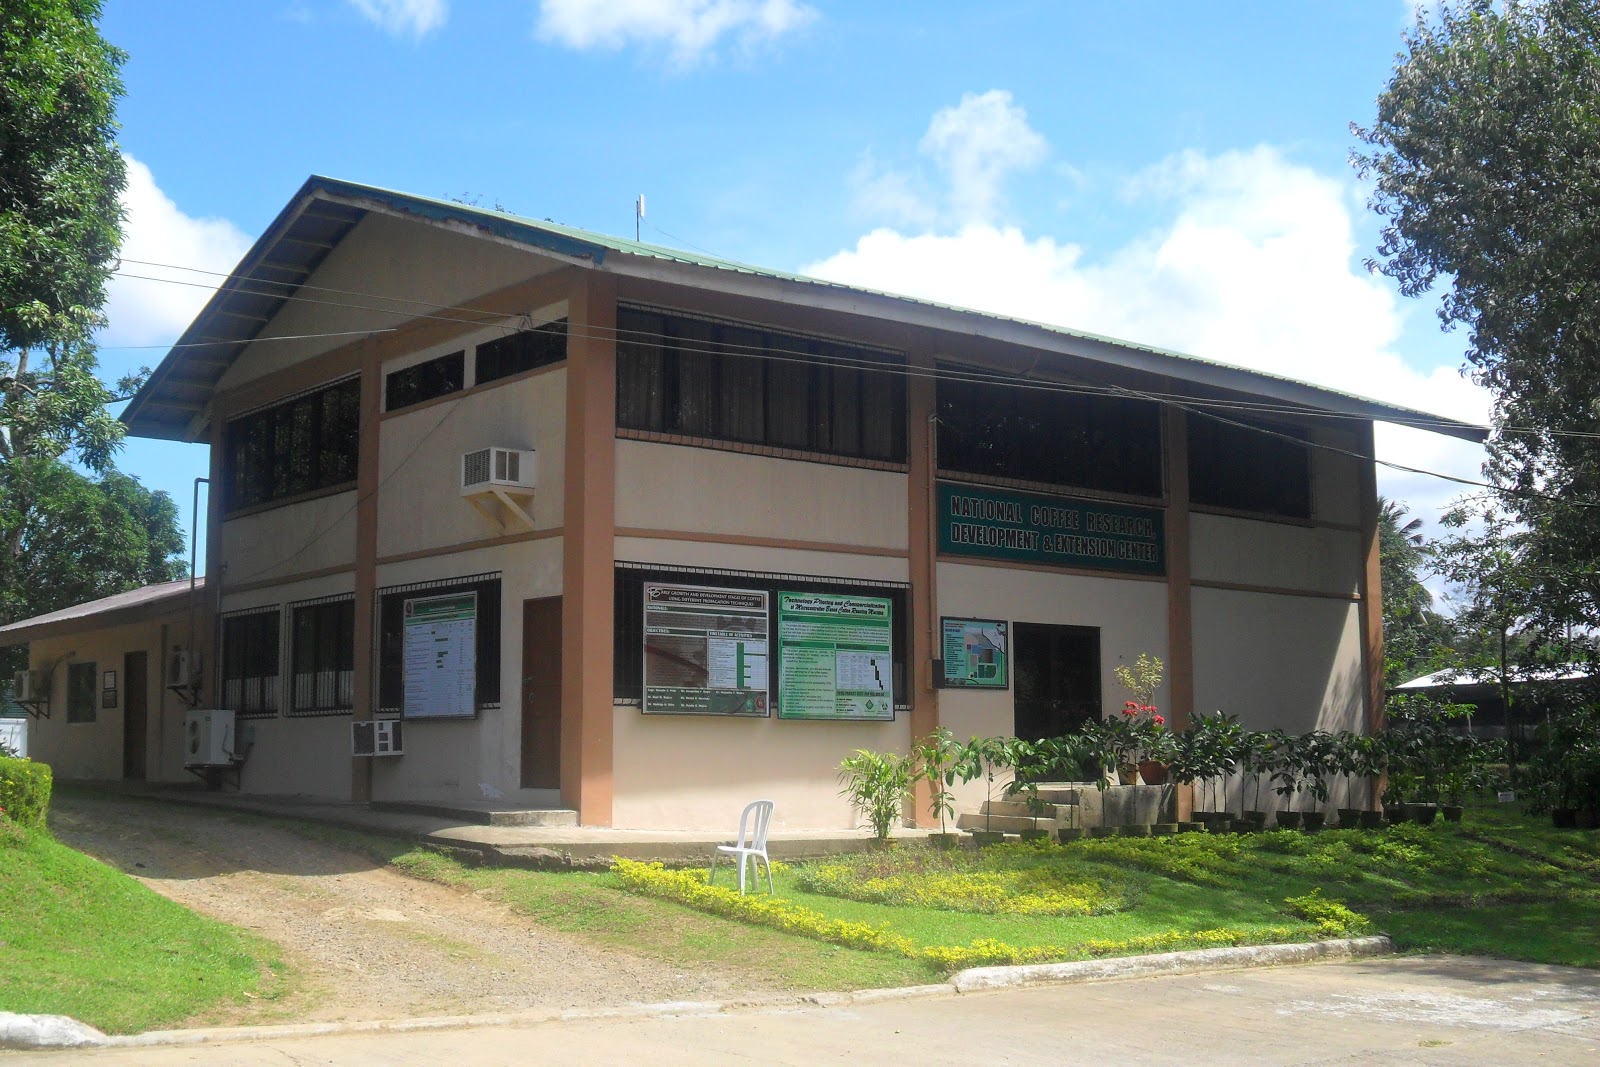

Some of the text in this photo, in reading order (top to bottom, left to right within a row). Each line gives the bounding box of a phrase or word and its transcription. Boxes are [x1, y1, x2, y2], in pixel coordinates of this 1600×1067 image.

[951, 495, 1157, 540] NATIONAL COFFEE RESEARCH,
[951, 522, 1159, 563] DEVELOPMENT & EXTENSION CENTER
